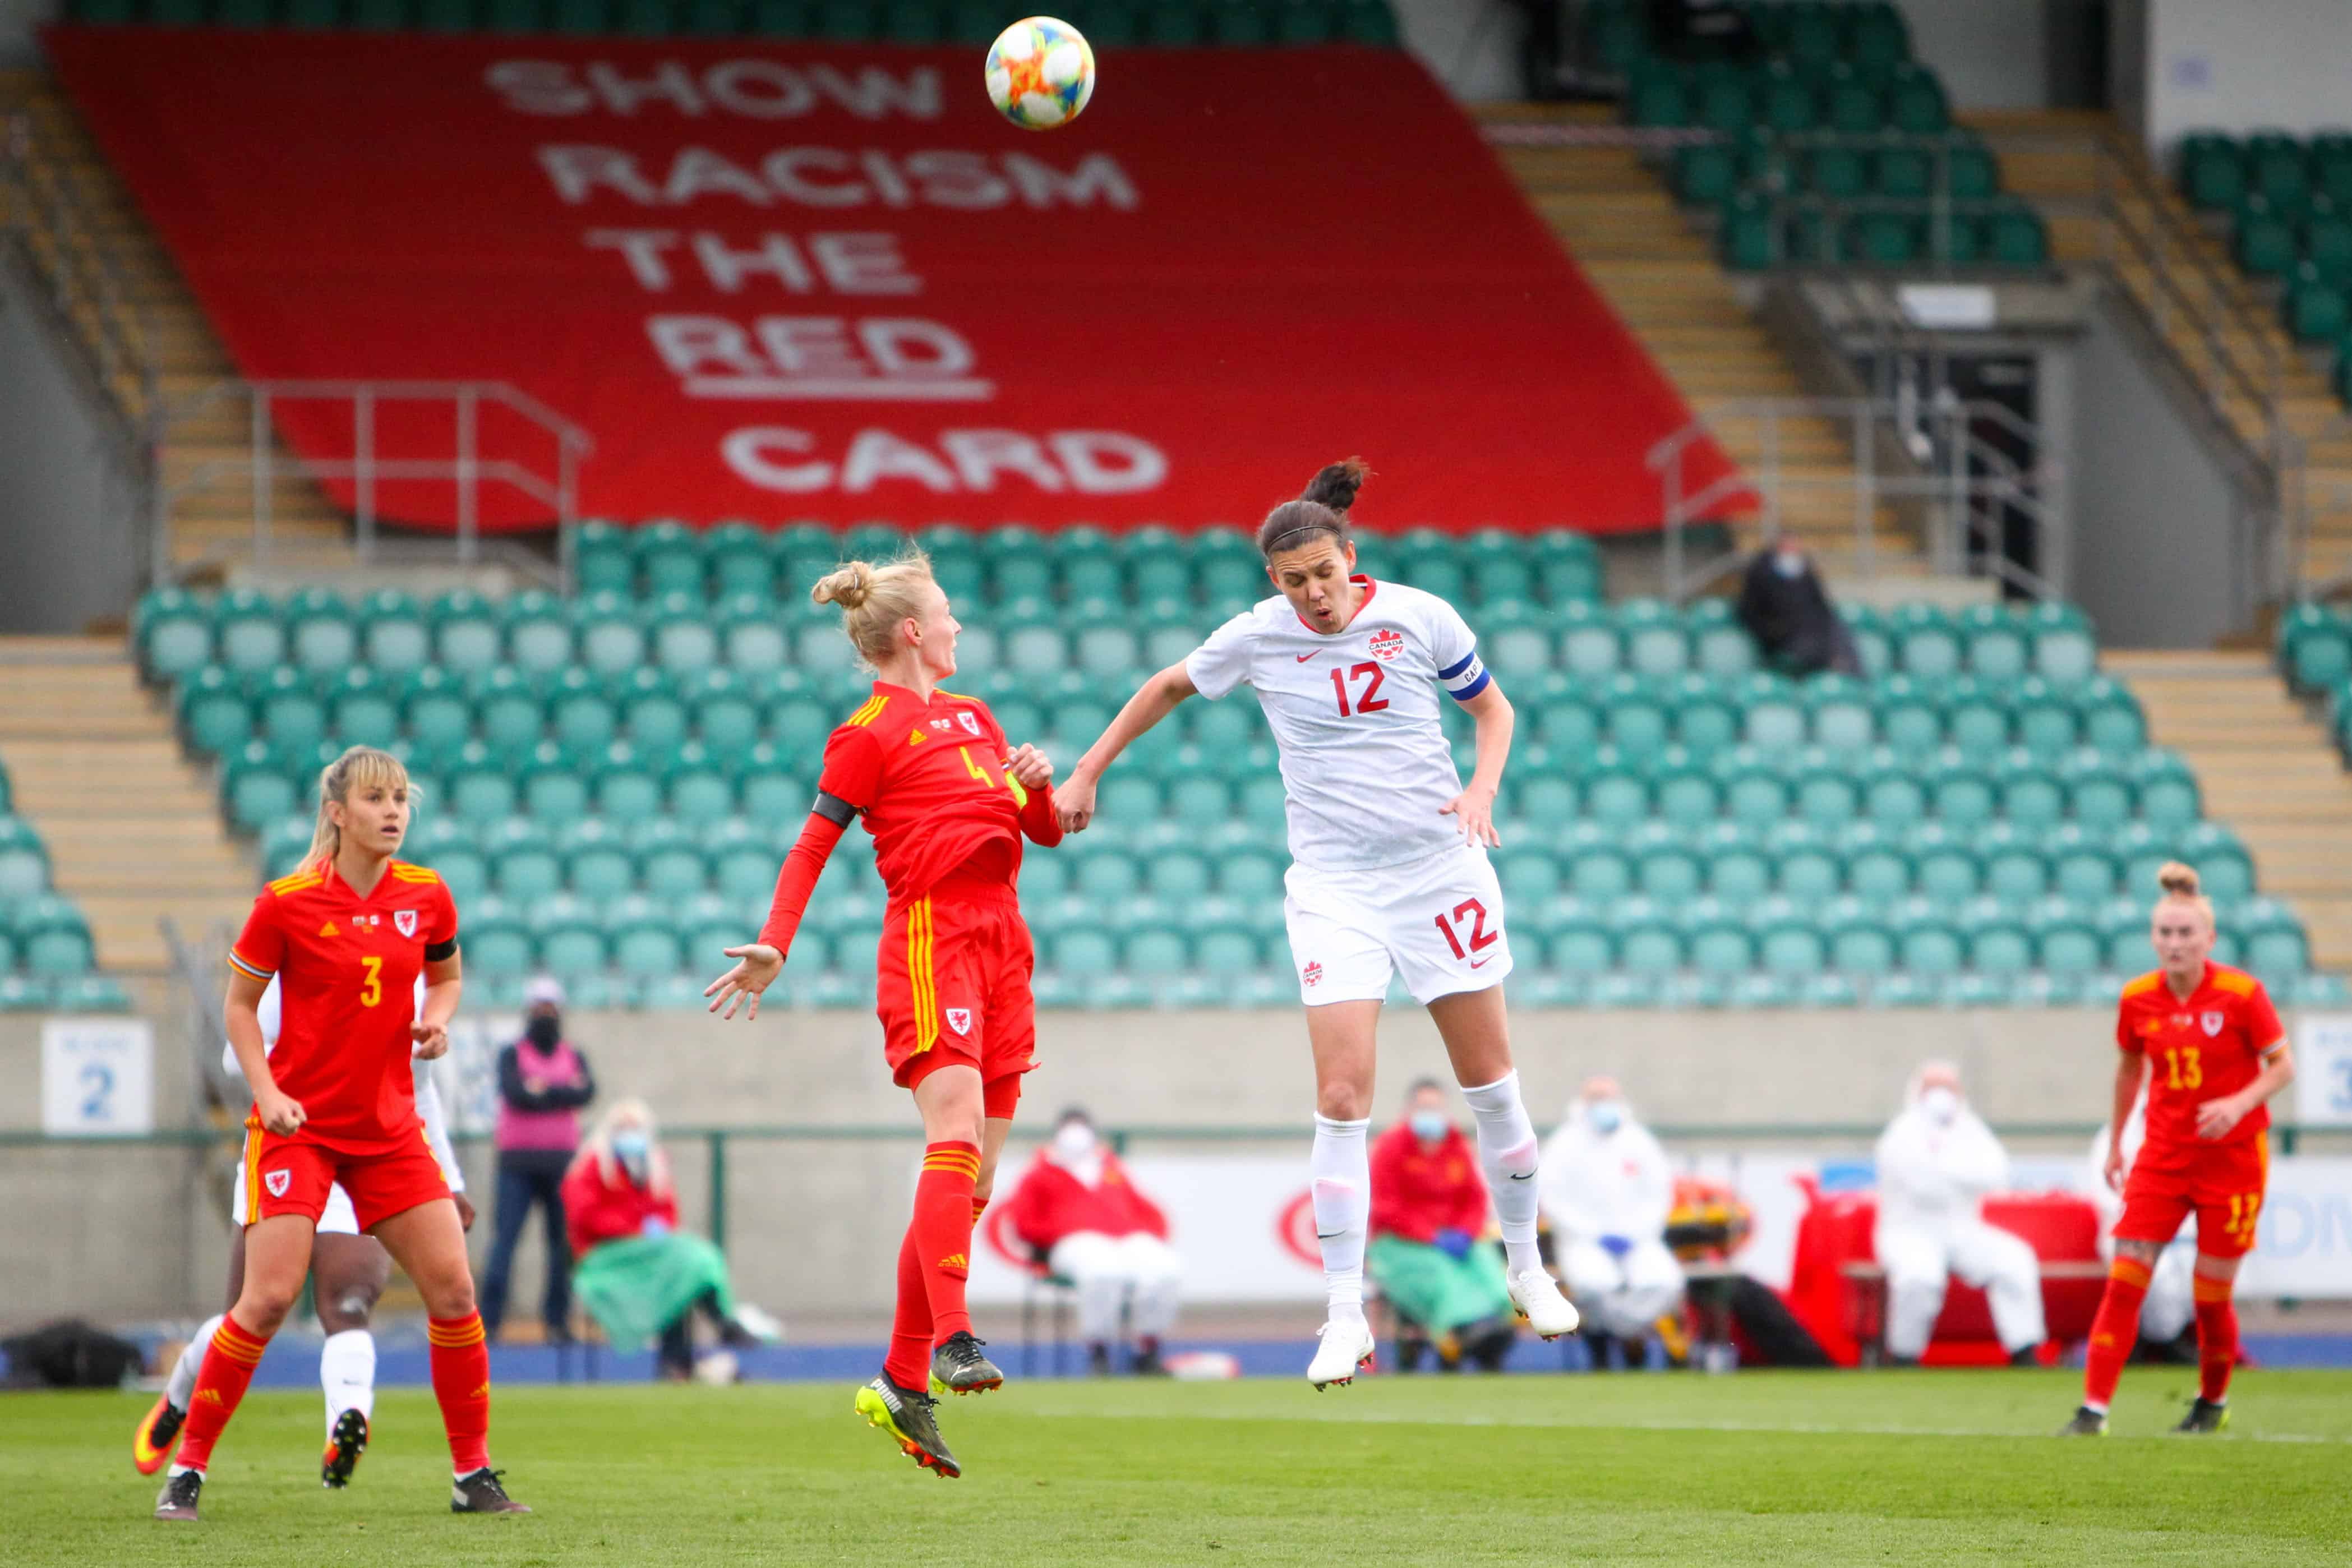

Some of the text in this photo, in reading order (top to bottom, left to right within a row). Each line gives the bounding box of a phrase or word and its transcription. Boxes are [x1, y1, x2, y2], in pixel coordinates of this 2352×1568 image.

[486, 58, 943, 119] SHOW
[537, 144, 1140, 210] RACISM
[582, 228, 923, 295] THE
[645, 313, 975, 377] RED
[720, 425, 1168, 494] CARD
[1368, 639, 1404, 651] CANADA
[1330, 661, 1390, 717] 12
[960, 746, 994, 788] 4
[1435, 897, 1498, 960] 12
[360, 956, 382, 1007] 3
[80, 1061, 117, 1121] 2
[2165, 1046, 2203, 1090] 13
[870, 1378, 902, 1414] PUMA
